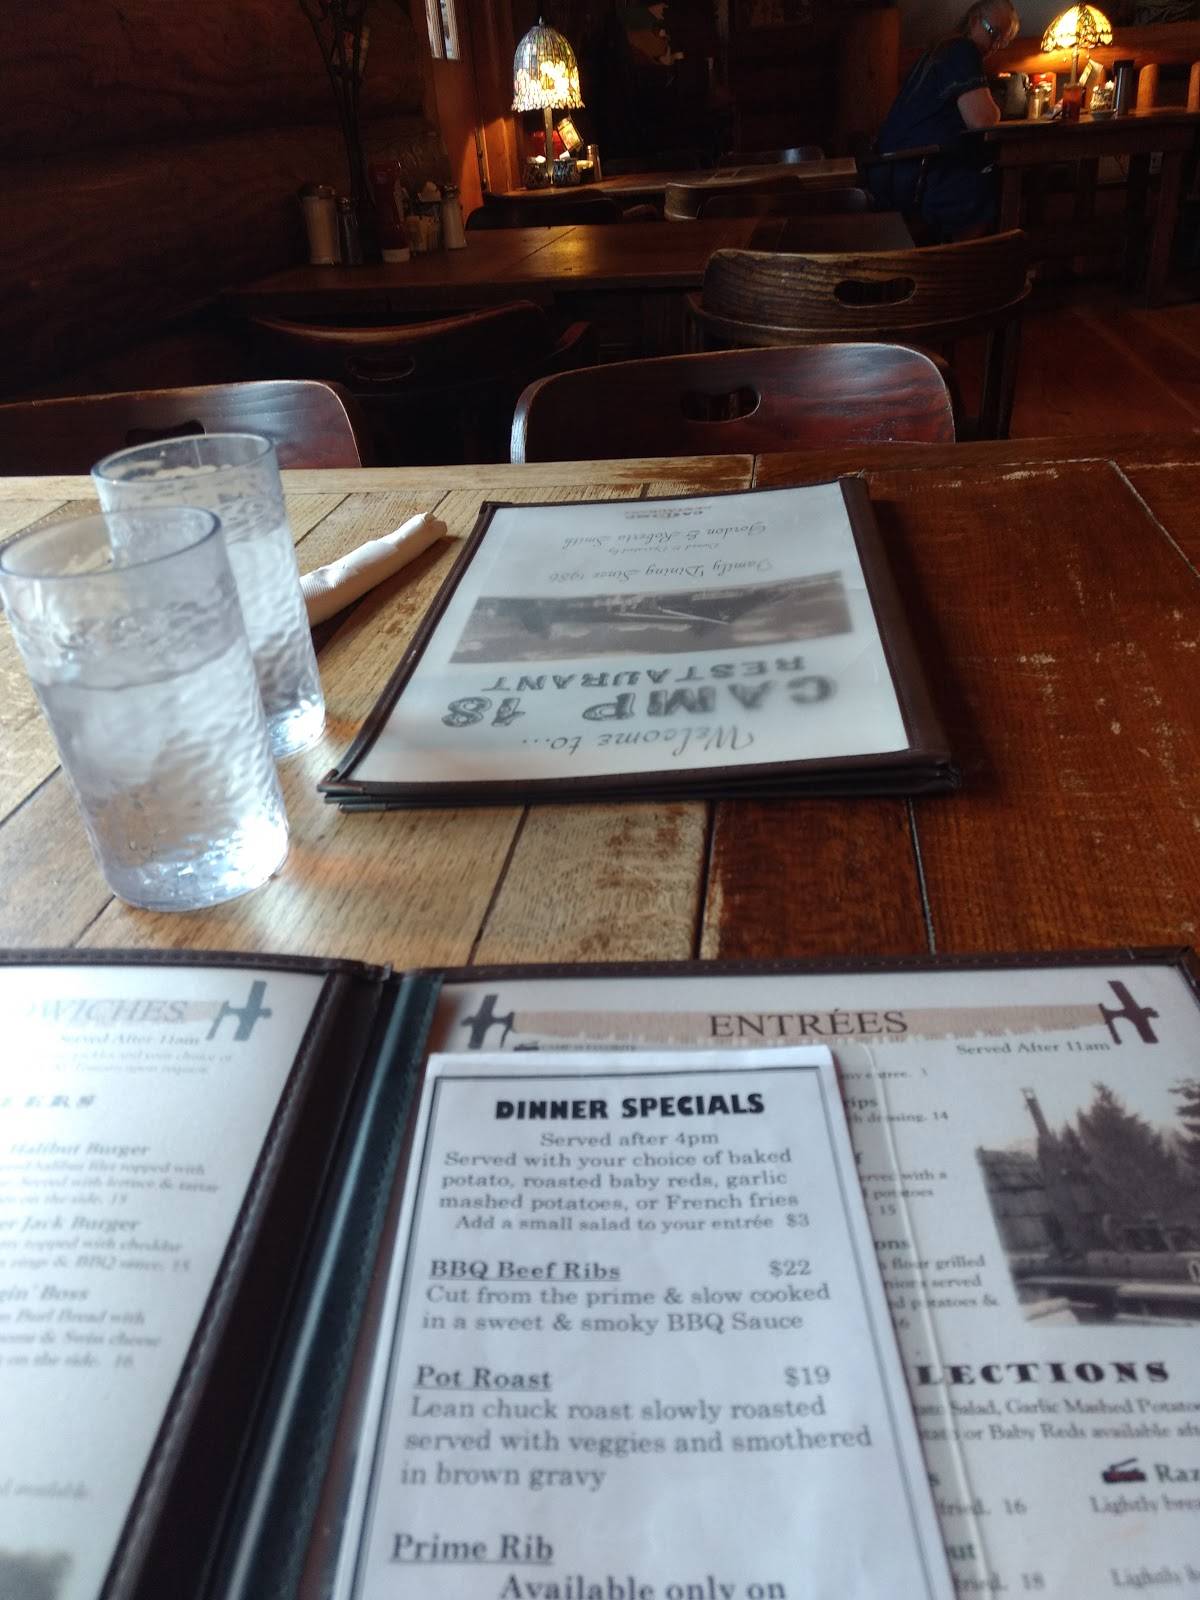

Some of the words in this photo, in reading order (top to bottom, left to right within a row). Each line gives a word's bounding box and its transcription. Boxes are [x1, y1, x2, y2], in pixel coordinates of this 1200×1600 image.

[481, 656, 807, 692] RESTAURANT
[581, 676, 839, 722] CAMP
[440, 696, 527, 729] 18
[598, 724, 760, 758] Welcome
[709, 1008, 908, 1038] ENTRÉES
[956, 1043, 1011, 1056] Served
[1017, 1042, 1059, 1055] After
[495, 1098, 610, 1120] DINNER
[621, 1092, 765, 1118] SPECIALS
[540, 1131, 612, 1148] Served
[618, 1131, 668, 1147] after
[674, 1131, 720, 1151] 4pm
[443, 1152, 518, 1168] Served
[523, 1152, 571, 1168] with
[577, 1156, 626, 1172] your
[632, 1150, 696, 1167] choice
[702, 1148, 722, 1166] of
[728, 1147, 792, 1165] baked
[441, 1174, 515, 1191] potato,
[523, 1173, 601, 1189] roasted
[609, 1172, 660, 1192] baby
[667, 1171, 719, 1189] reds,
[726, 1169, 788, 1189] garlic
[438, 1194, 523, 1211] mashed
[531, 1195, 625, 1214] potatoes,
[635, 1198, 659, 1210] or
[666, 1193, 740, 1210] French
[748, 1191, 799, 1208] fries
[71, 1215, 141, 1233] Burger
[454, 1215, 495, 1231] Add
[501, 1220, 512, 1230] a
[518, 1215, 573, 1231] small
[578, 1216, 632, 1233] salad
[637, 1218, 656, 1231] to
[660, 1220, 707, 1236] your
[711, 1214, 774, 1230] entrée
[785, 1213, 810, 1229] $3
[429, 1260, 490, 1281] BBQ
[497, 1260, 557, 1279] Beef
[564, 1260, 622, 1280] Ribs
[768, 1259, 813, 1277] $22
[935, 1254, 985, 1271] grilled
[931, 1275, 982, 1289] served
[425, 1285, 469, 1304] Cut
[475, 1286, 532, 1304] from
[540, 1287, 578, 1304] the
[584, 1288, 655, 1309] prime
[664, 1288, 682, 1303] &
[690, 1286, 743, 1303] slow
[750, 1283, 831, 1302] cooked
[910, 1295, 981, 1309] ptatoes
[422, 1313, 449, 1330] in
[454, 1318, 468, 1330] a
[475, 1315, 543, 1332] sweet
[552, 1314, 572, 1331] &
[580, 1313, 660, 1336] smoky
[666, 1312, 725, 1334] BBQ
[731, 1311, 803, 1331] Sauce
[413, 1366, 465, 1389] Pot
[473, 1367, 553, 1391] Roast
[783, 1365, 831, 1388] $19
[914, 1360, 1169, 1387] LECTIONS
[410, 1397, 475, 1419] Lean
[482, 1397, 558, 1420] chuck
[567, 1400, 633, 1420] roast
[641, 1398, 722, 1425] slowly
[730, 1396, 827, 1418] roasted
[1005, 1399, 1061, 1415] Garlic
[1065, 1399, 1133, 1414] Mashed
[404, 1430, 491, 1452] served
[500, 1431, 560, 1453] with
[568, 1433, 666, 1458] veggies
[673, 1432, 723, 1453] and
[732, 1425, 872, 1452] smothered
[988, 1424, 1036, 1442] Baby
[1040, 1422, 1086, 1439] Reds
[1091, 1423, 1169, 1439] available
[400, 1464, 427, 1485] in
[435, 1463, 520, 1486] brown
[528, 1467, 607, 1492] gravy
[1004, 1498, 1028, 1515] 16
[1089, 1495, 1159, 1516] Lightly
[389, 1534, 488, 1564] Prime
[500, 1534, 554, 1564] Rib
[500, 1575, 655, 1600] Available
[665, 1576, 737, 1600] only
[746, 1581, 786, 1600] on
[1021, 1573, 1045, 1591] 18
